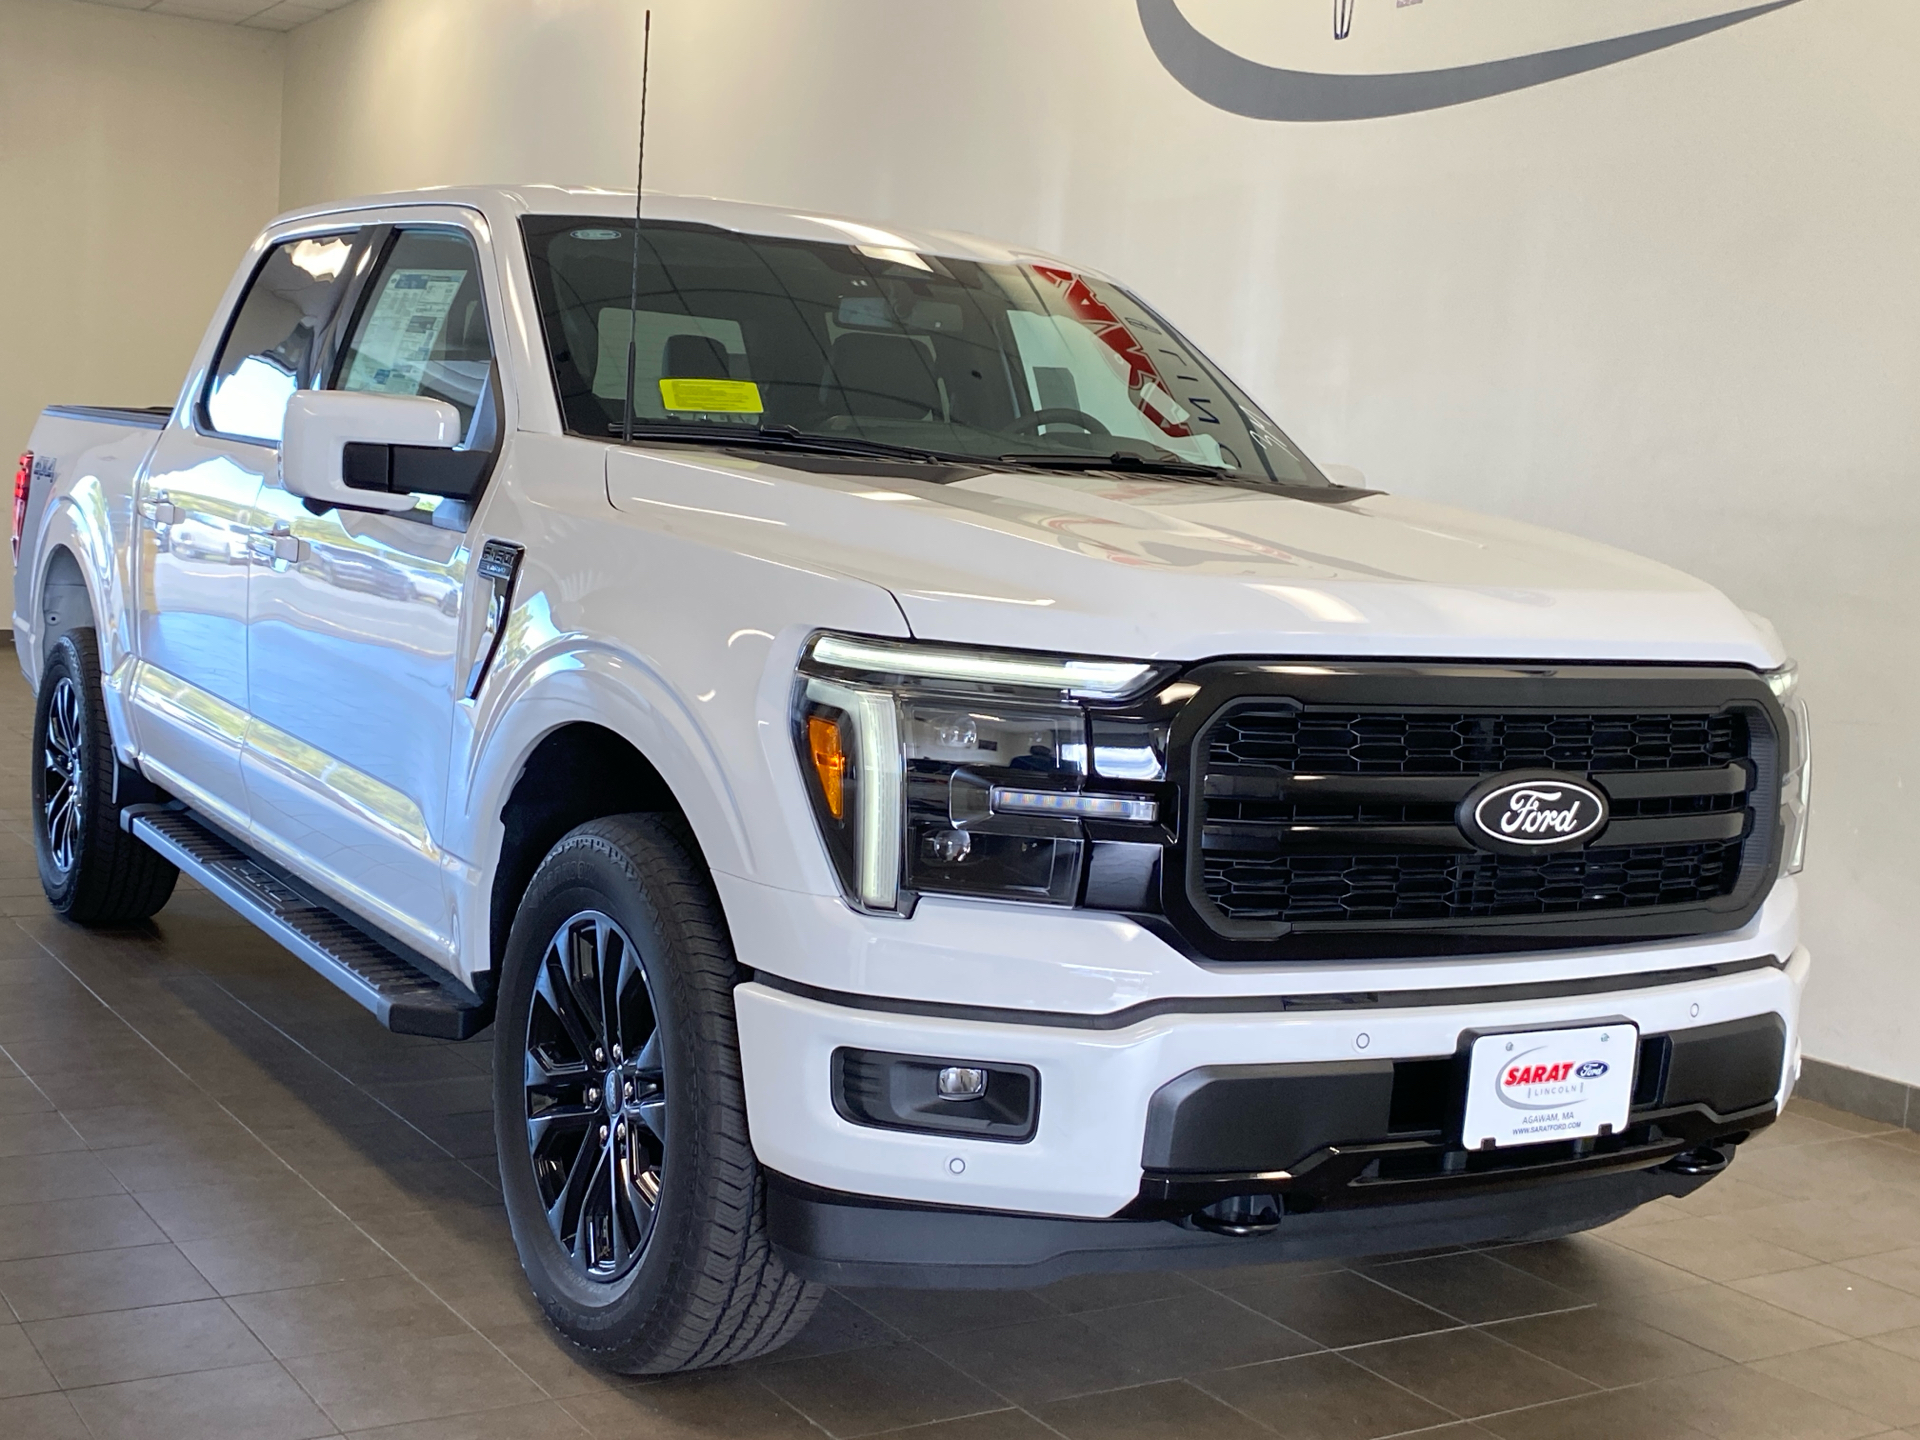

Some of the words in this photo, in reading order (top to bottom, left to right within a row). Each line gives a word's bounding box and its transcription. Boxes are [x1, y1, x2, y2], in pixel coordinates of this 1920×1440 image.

[1500, 789, 1581, 834] Ford
[1504, 1062, 1574, 1086] SARAT
[1578, 1062, 1606, 1078] Ford
[1534, 1086, 1577, 1096] LINCOLN
[1522, 1113, 1560, 1124] AGAWAM,
[1562, 1112, 1574, 1120] MA
[1513, 1122, 1581, 1135] WWW.SARATFORD.COM
